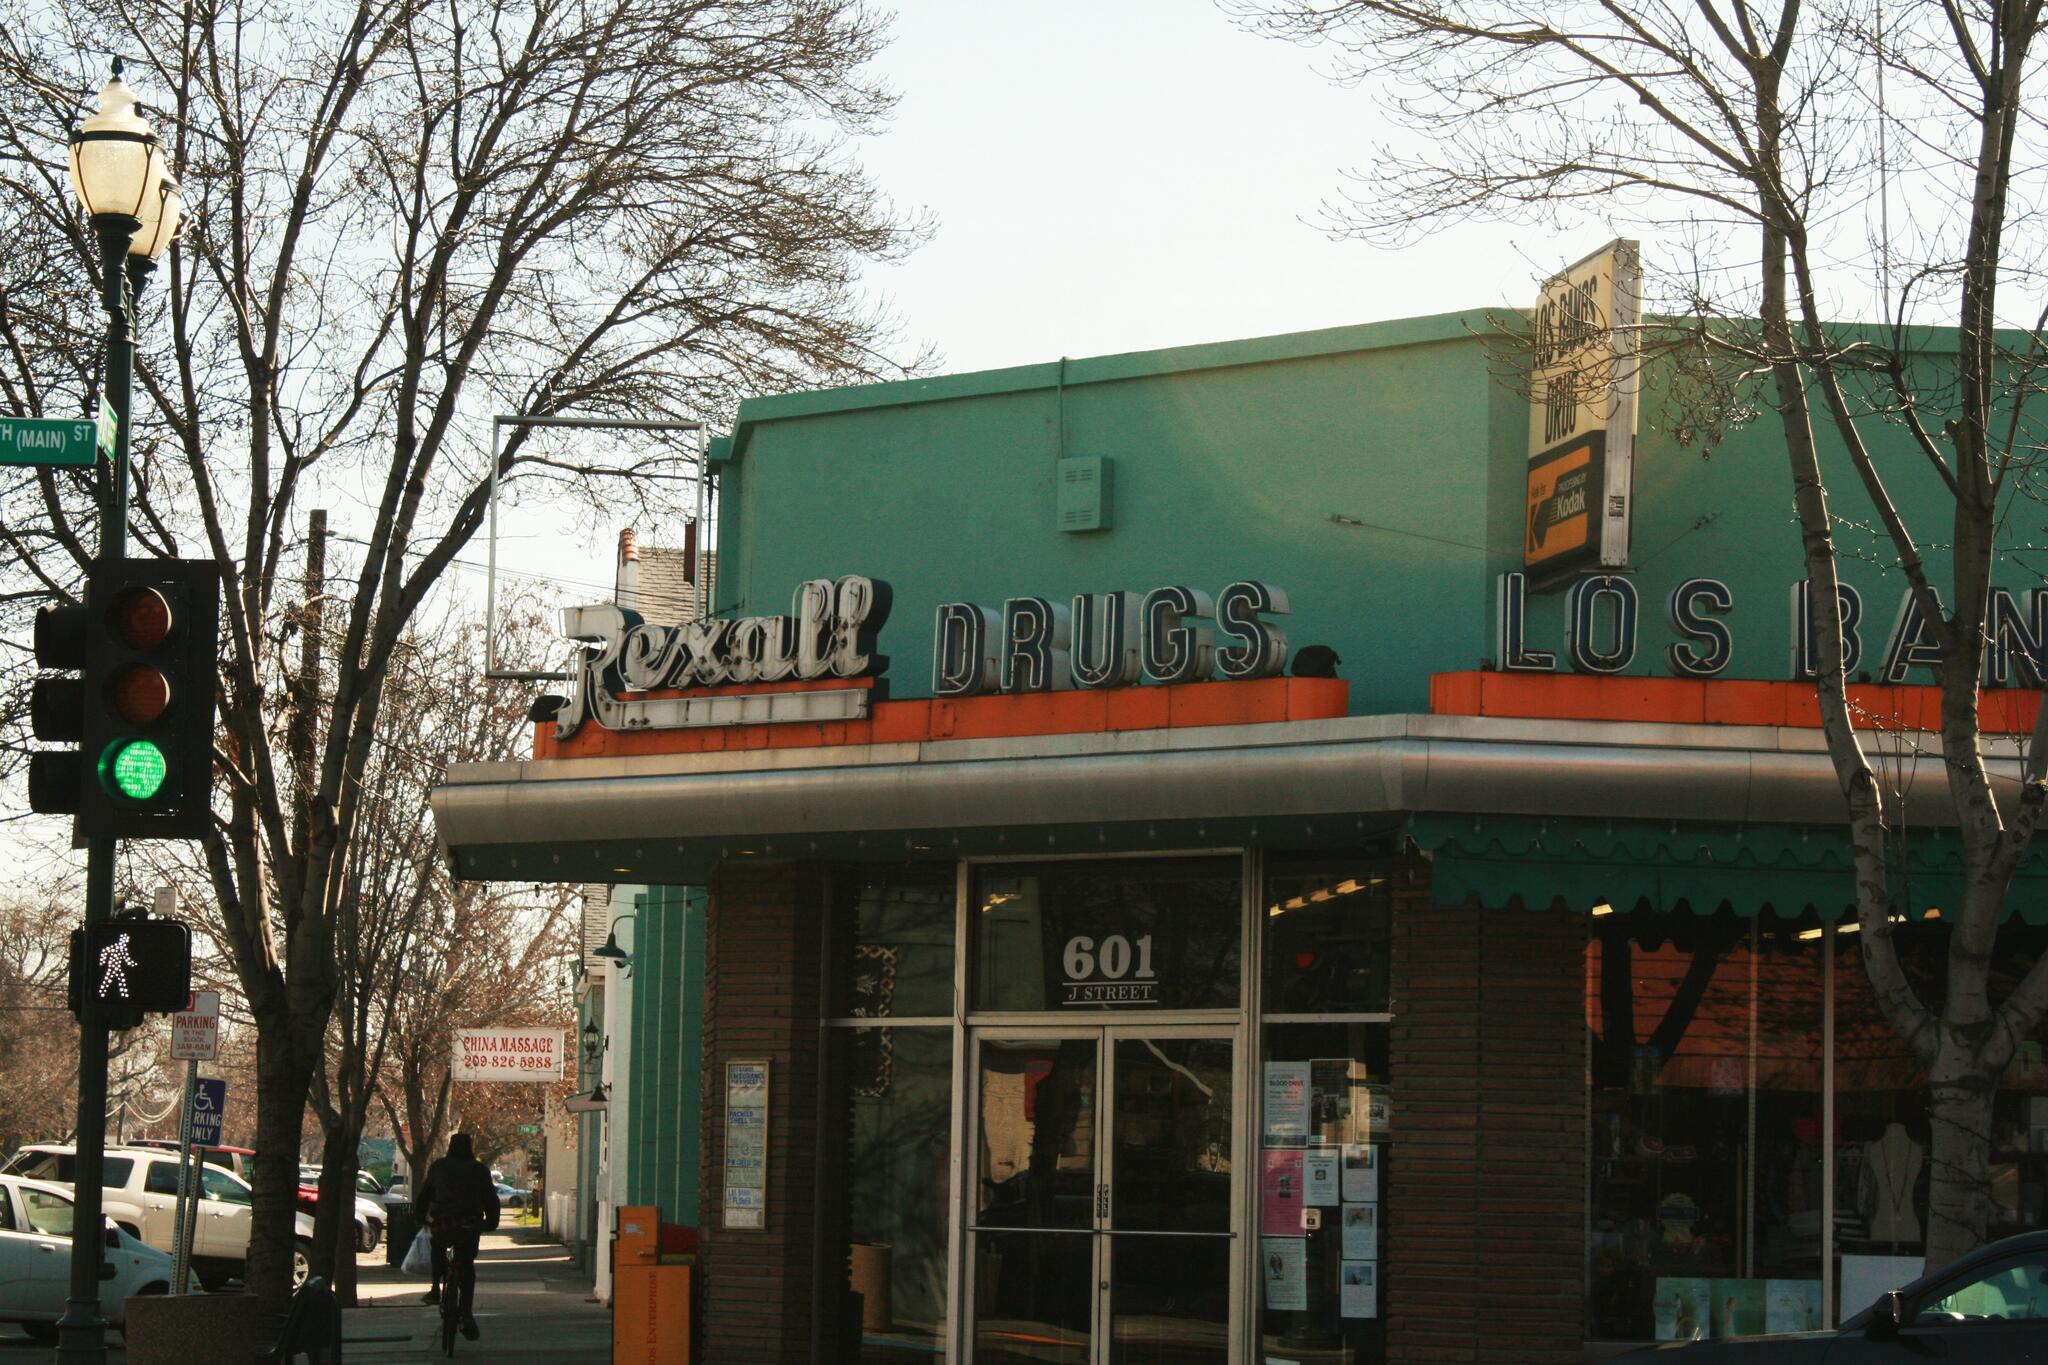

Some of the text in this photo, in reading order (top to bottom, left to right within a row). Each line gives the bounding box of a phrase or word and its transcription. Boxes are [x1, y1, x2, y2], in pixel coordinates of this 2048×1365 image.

[0, 423, 91, 453] H (MAIN) ST
[1557, 487, 1585, 520] Kodak
[932, 580, 1284, 697] DRUGS
[1501, 570, 1733, 676] LOS
[558, 574, 888, 740] Rexall
[1063, 934, 1155, 980] 601
[1068, 985, 1152, 1001] J STREET
[176, 1015, 215, 1029] PARKING
[463, 1036, 553, 1053] CHINA MASSAGE
[193, 1111, 222, 1127] RKING
